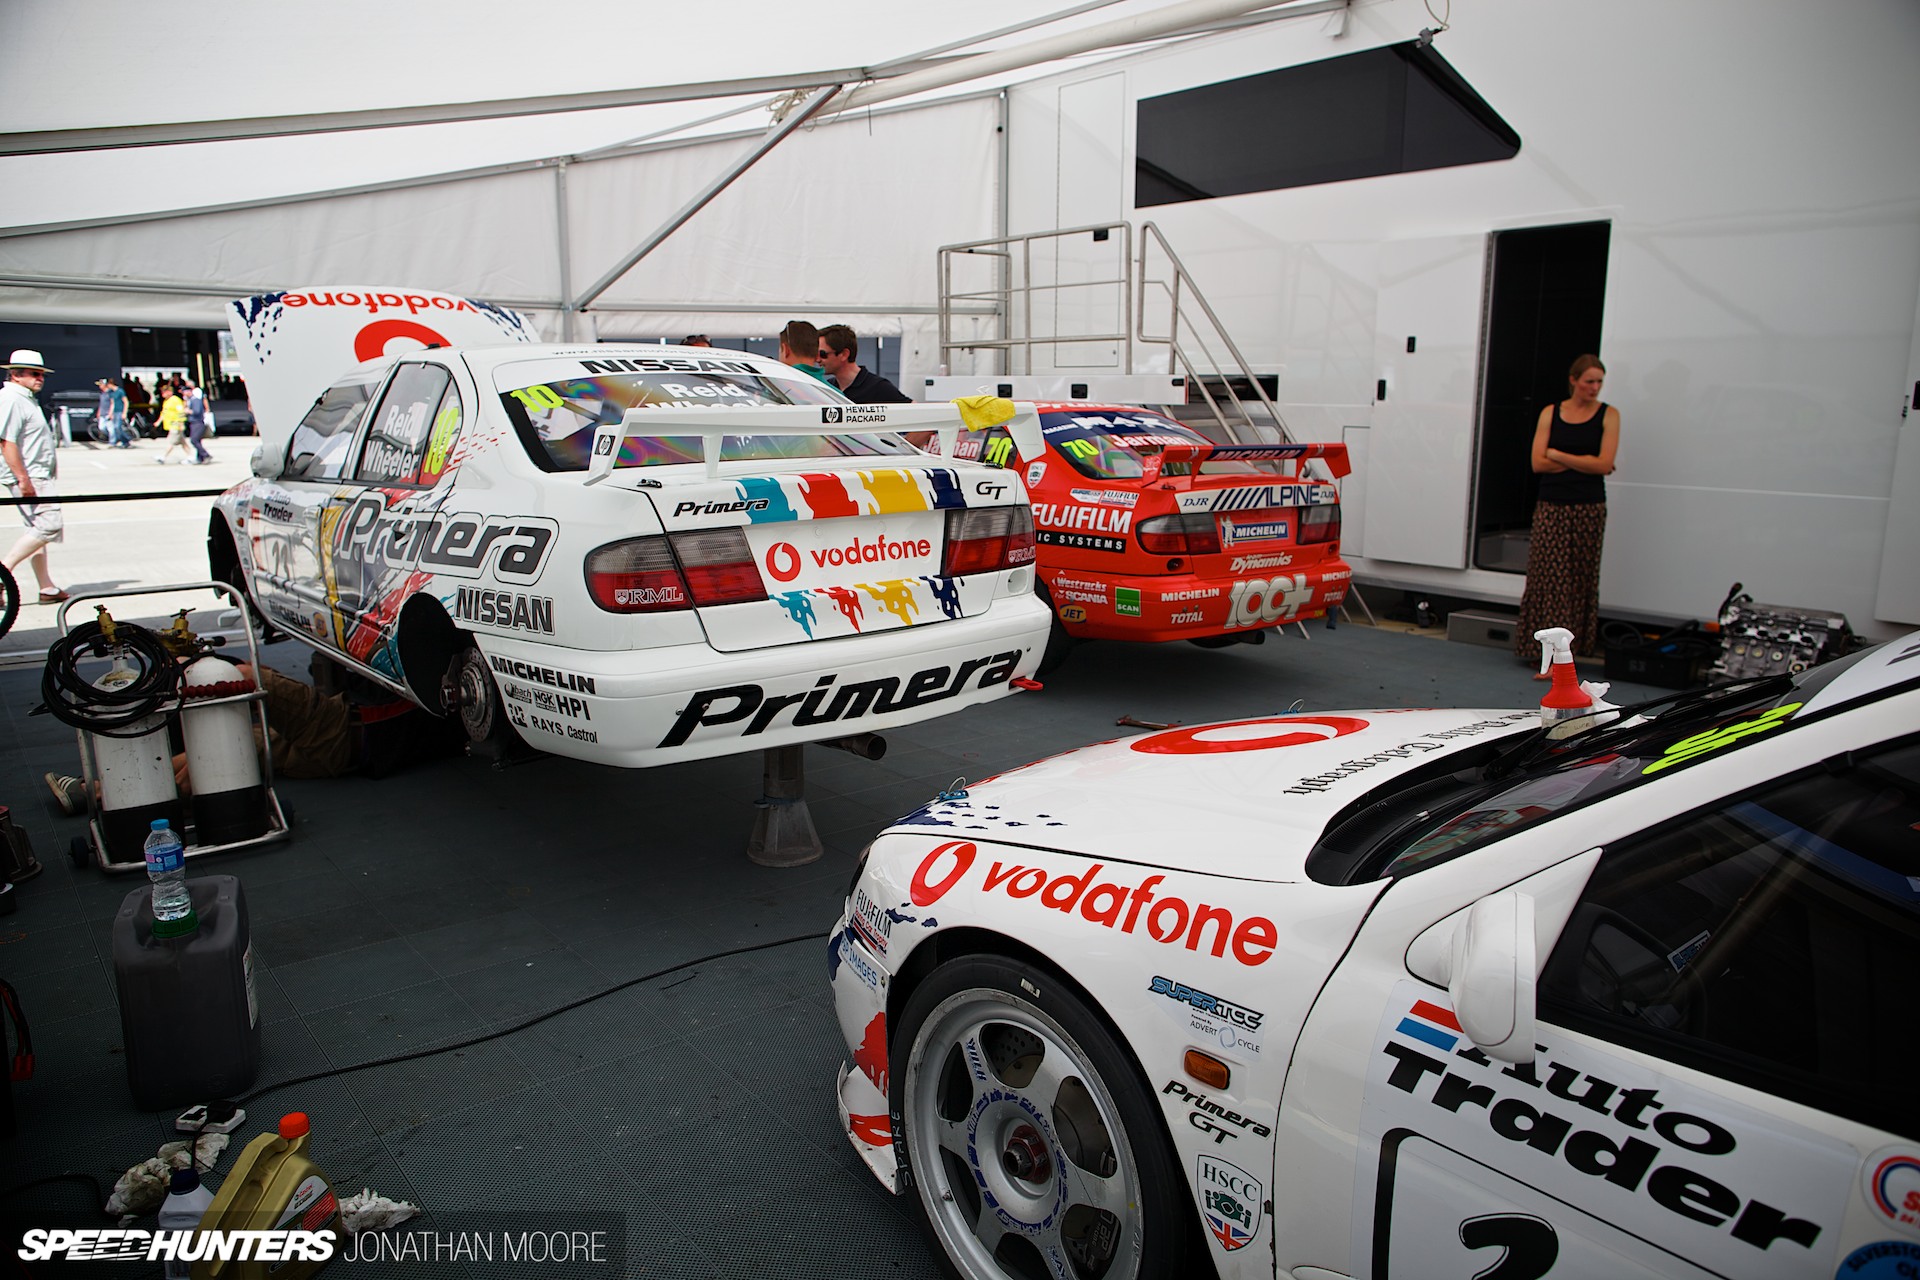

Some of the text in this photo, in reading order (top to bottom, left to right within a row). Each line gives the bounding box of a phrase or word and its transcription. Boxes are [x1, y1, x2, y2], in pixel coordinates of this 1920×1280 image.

[282, 292, 479, 315] vodafone
[579, 359, 763, 375] NISSAN
[510, 385, 564, 413] 10
[660, 382, 748, 399] Reid
[845, 406, 886, 414] HEWLETT
[846, 414, 886, 423] PACKARD
[424, 407, 459, 476] 10
[923, 433, 980, 458] Jaman
[1061, 438, 1099, 459] 70
[1110, 434, 1193, 448] Jarman
[363, 439, 420, 478] Wheeler
[985, 437, 1013, 469] 70
[1212, 449, 1301, 461] MICHELIN
[976, 481, 1008, 500] GT
[1104, 489, 1138, 501] FUJIFILM
[264, 502, 293, 523] Trader
[673, 497, 769, 518] Primera
[1182, 497, 1209, 507] DJR
[1031, 503, 1133, 534] FUJIFILM
[343, 497, 556, 581] Primera
[1236, 525, 1286, 537] MICHELIN
[810, 534, 931, 568] vodafone
[1059, 535, 1123, 550] SYSTEMS
[1230, 552, 1293, 574] Dynamics
[629, 586, 684, 604] RML
[1056, 577, 1107, 592] Westrucks
[1161, 587, 1220, 602] MICHELIN
[1065, 590, 1108, 605] SCANIA
[1117, 603, 1140, 613] SCAN
[455, 585, 555, 635] NISSAN
[1063, 608, 1084, 619] JET
[1171, 611, 1203, 625] TOTAL
[491, 655, 597, 695] MICHELIN
[533, 691, 555, 706] NGK
[556, 694, 591, 721] HPI
[656, 649, 1023, 749] Primera
[531, 715, 564, 736] RAYS
[567, 725, 599, 744] Castrol
[1283, 742, 1445, 795] Telegraph
[856, 888, 892, 939] FUJIFILM
[982, 862, 1279, 967] vodafone
[849, 948, 877, 986] IMAGES
[1190, 1020, 1260, 1053] ADVERT CYCLE
[1162, 1080, 1271, 1138] Primera
[1189, 1111, 1238, 1144] GT
[1383, 1040, 1823, 1251] Trader
[1203, 1161, 1257, 1202] HSCC
